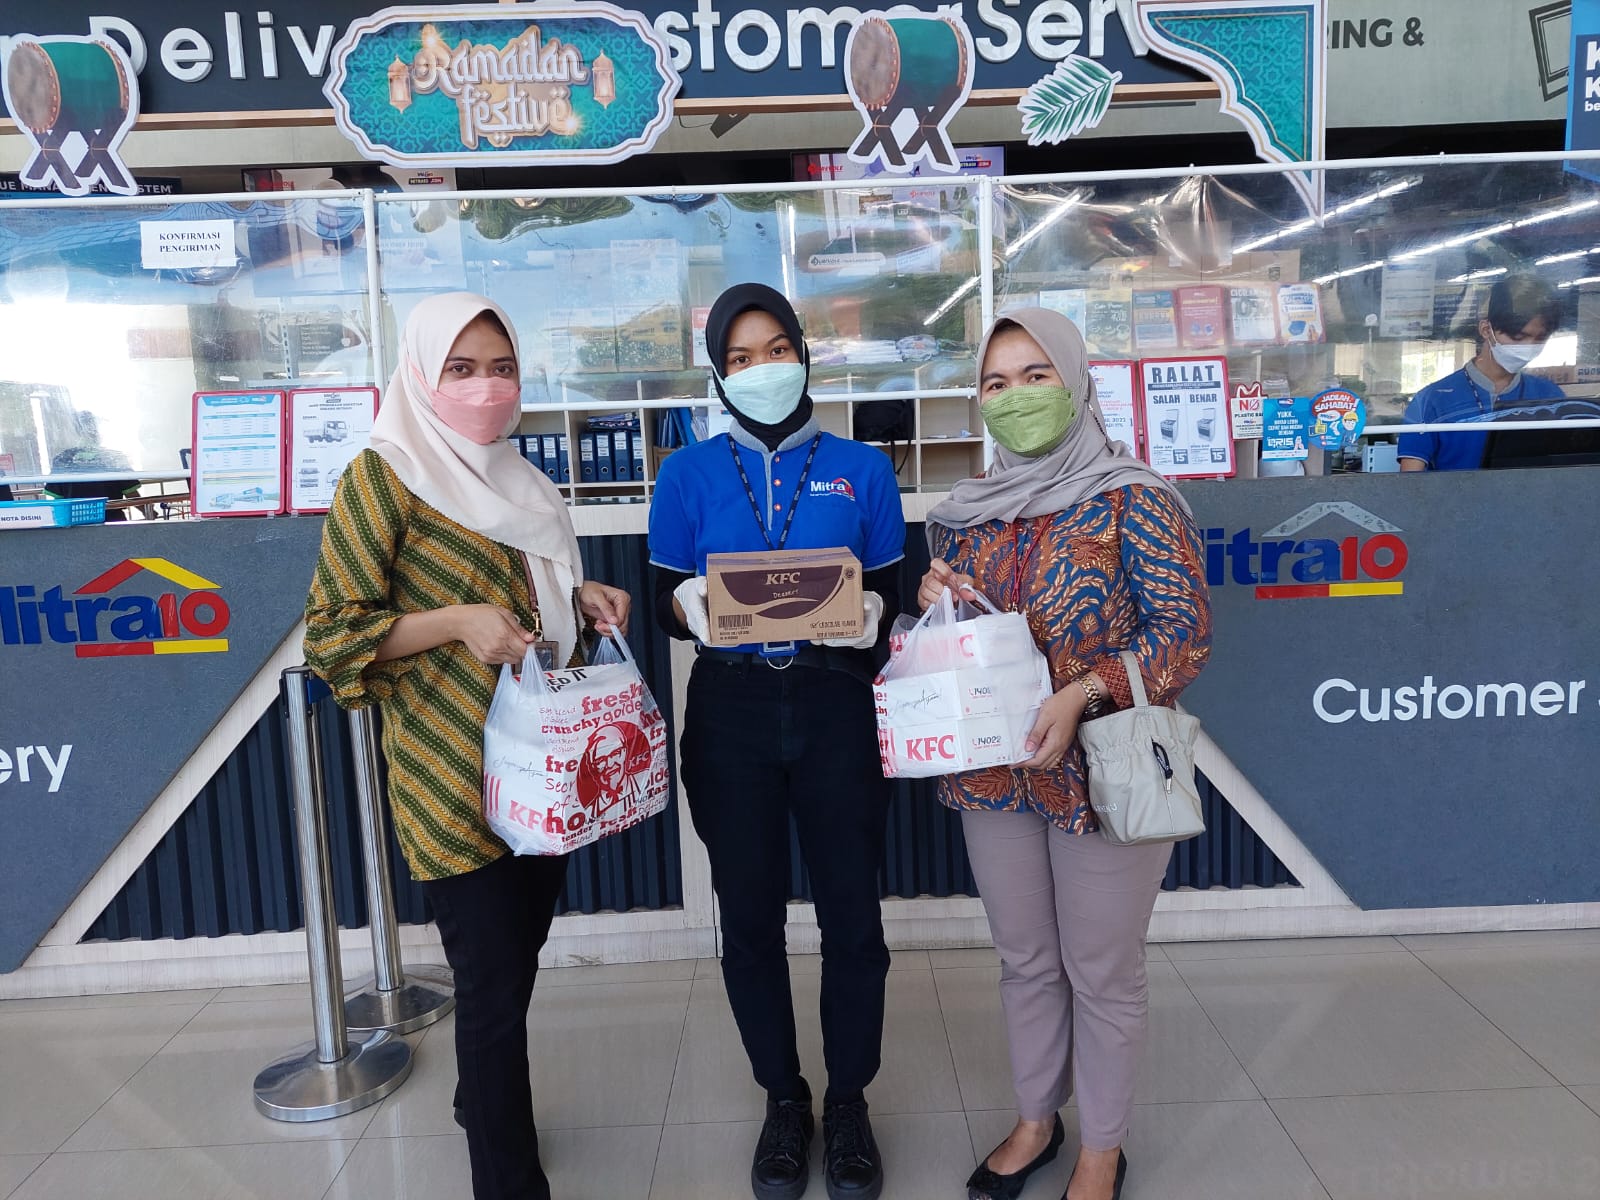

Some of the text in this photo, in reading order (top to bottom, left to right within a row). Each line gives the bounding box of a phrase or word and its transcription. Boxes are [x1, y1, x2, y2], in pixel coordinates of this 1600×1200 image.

[1327, 17, 1425, 49] ING &
[159, 231, 221, 241] KONFIRMASI
[159, 243, 222, 253] PENGIRIMAN
[1152, 365, 1215, 383] RALAT
[1153, 395, 1181, 404] SALAH
[1189, 394, 1218, 403] BENAR
[1268, 437, 1294, 448] QRIS
[1202, 527, 1409, 586] itra10
[766, 572, 800, 585] KFC
[581, 682, 643, 715] fresh
[1313, 675, 1586, 724] Customer
[905, 734, 956, 762] KFC
[977, 735, 1002, 746] 14022
[545, 755, 578, 774] fre
